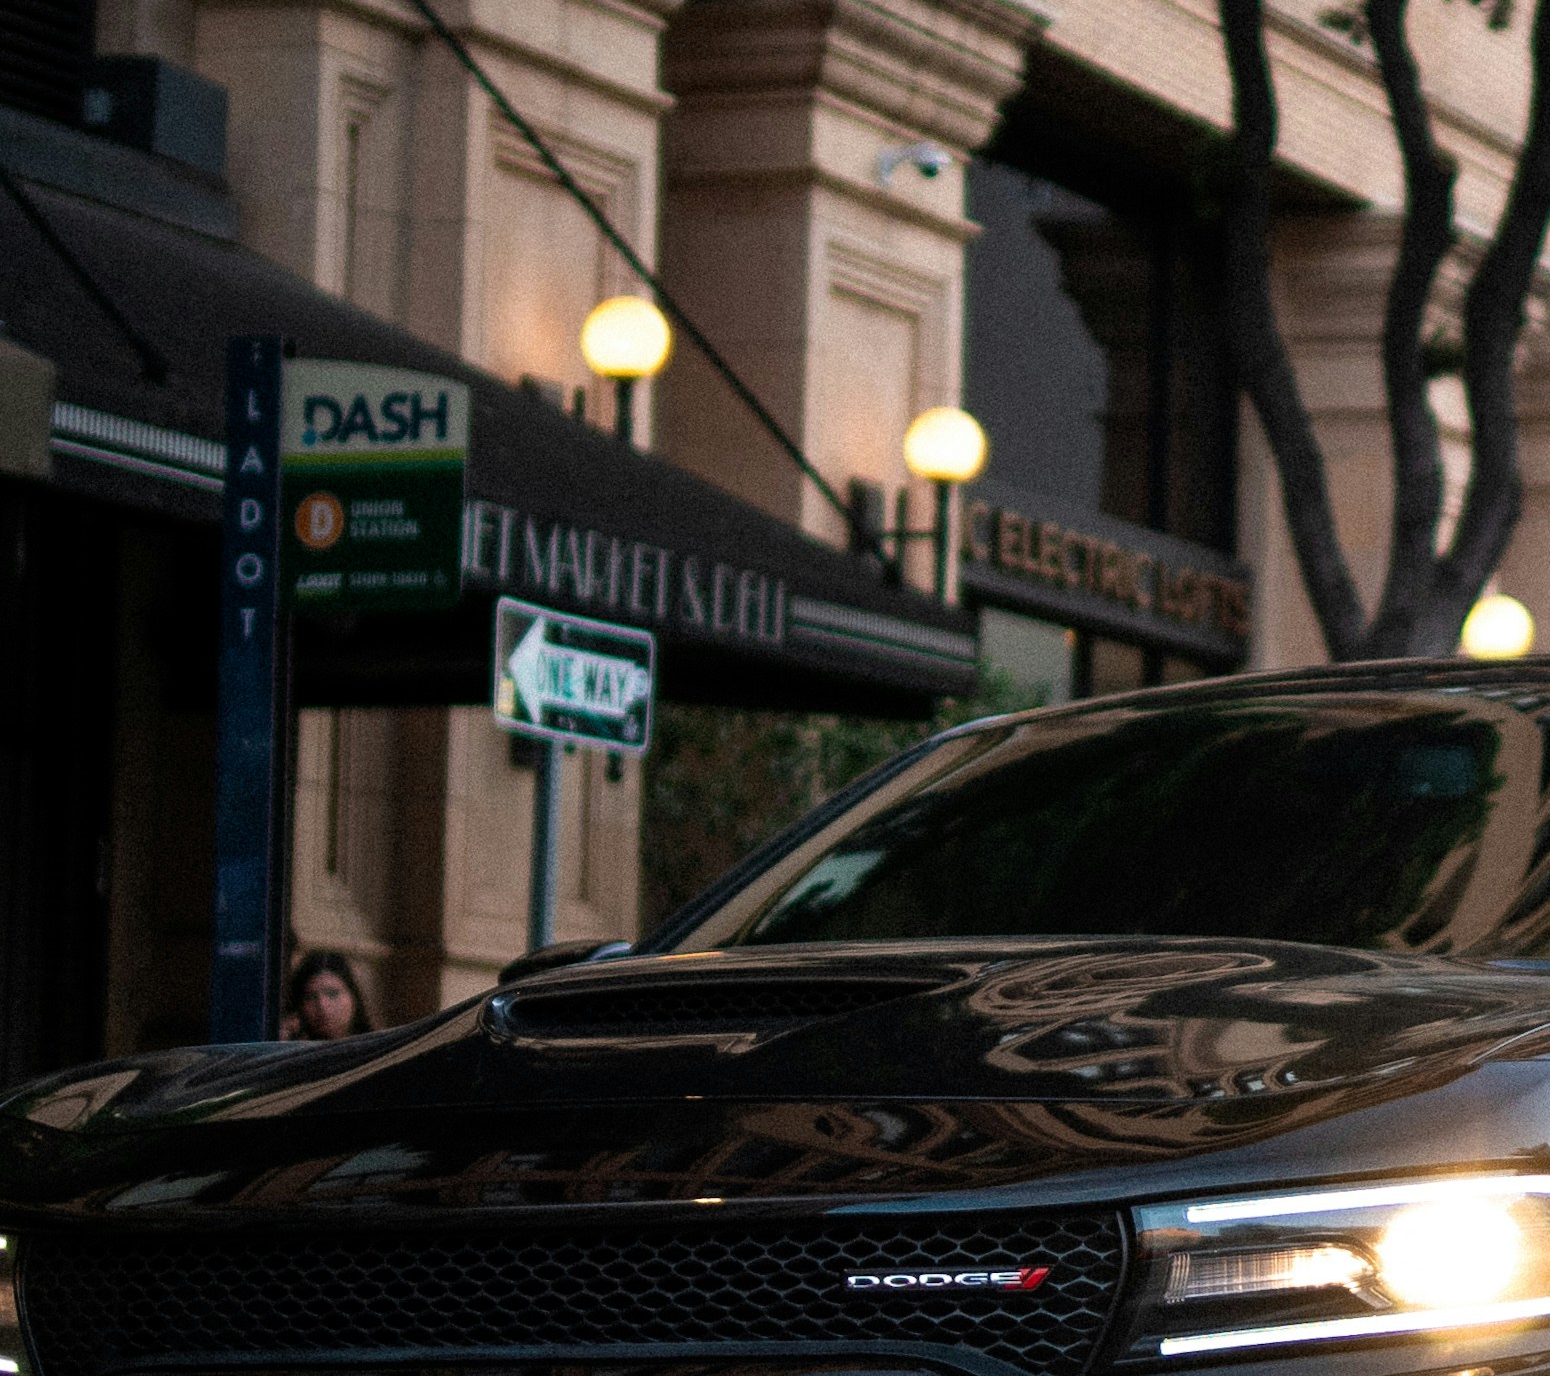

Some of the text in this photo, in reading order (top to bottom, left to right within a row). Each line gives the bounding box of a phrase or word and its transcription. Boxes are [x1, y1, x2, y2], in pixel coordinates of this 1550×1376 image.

[303, 391, 449, 445] DASH
[235, 388, 264, 639] LADOT
[310, 502, 334, 540] D
[536, 649, 628, 709] ONE WAY
[847, 1271, 1023, 1288] DODGE
